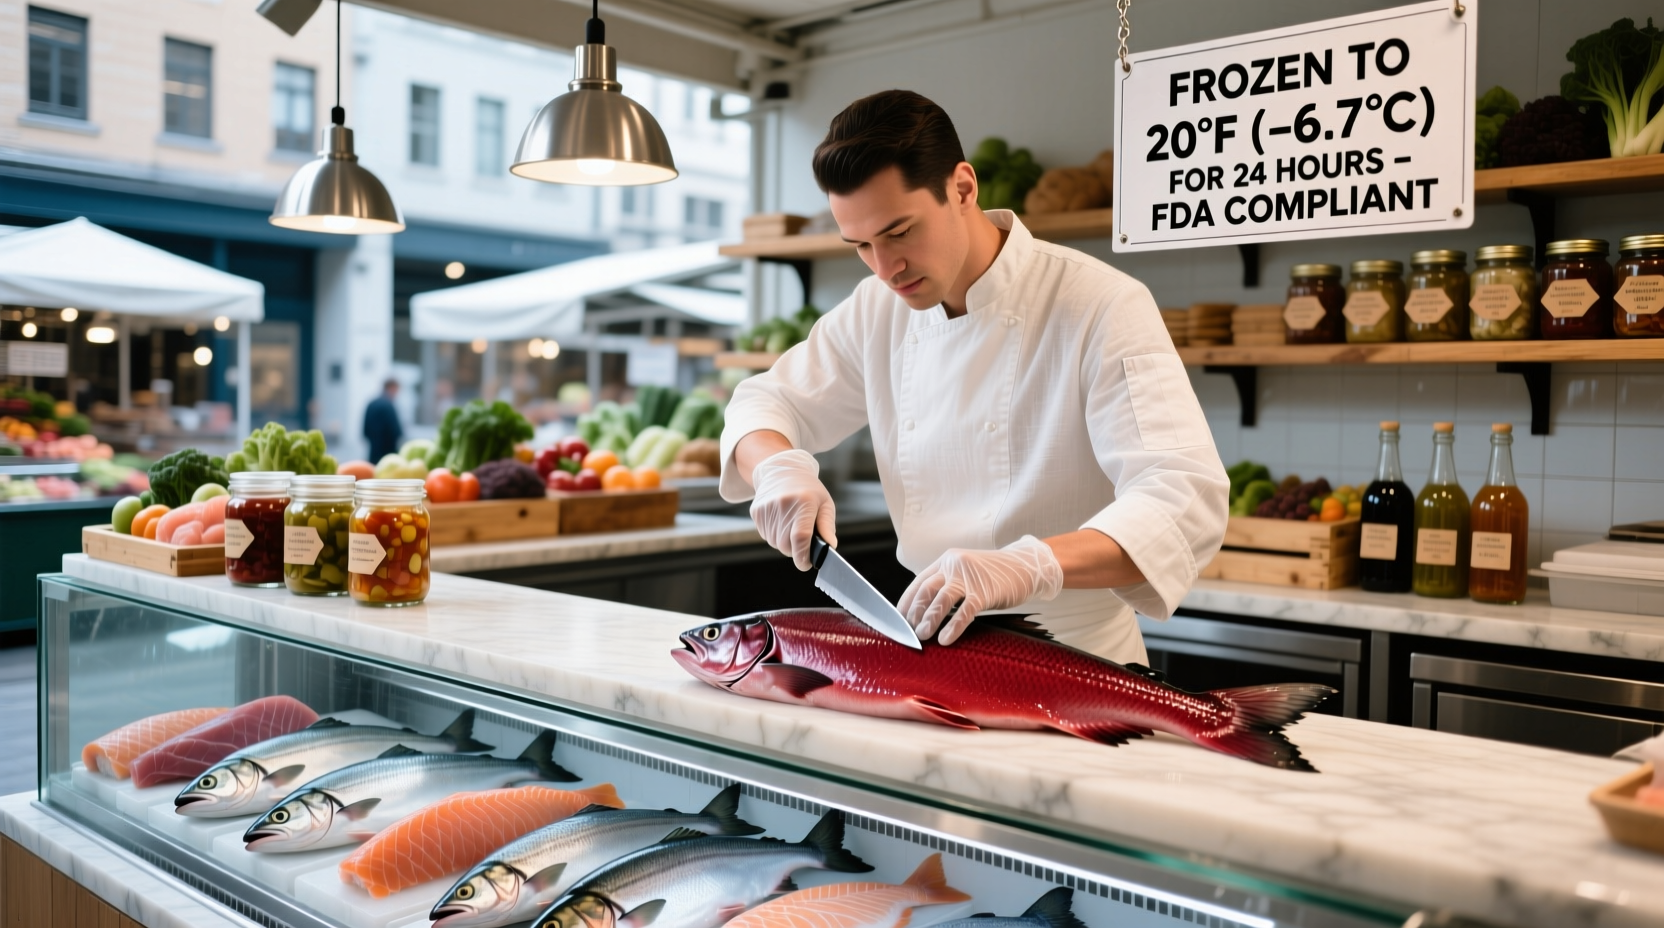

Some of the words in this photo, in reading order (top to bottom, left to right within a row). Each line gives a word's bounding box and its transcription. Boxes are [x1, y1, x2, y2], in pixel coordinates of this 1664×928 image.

[1170, 49, 1332, 107] FROZEN
[1348, 38, 1409, 80] TO
[1147, 115, 1237, 162] 20°F
[1170, 166, 1224, 194] FOR
[1234, 162, 1267, 187] 24
[1277, 148, 1384, 183] HOURS
[1152, 199, 1215, 231] FDA
[1225, 178, 1438, 225] COMPLIANT
